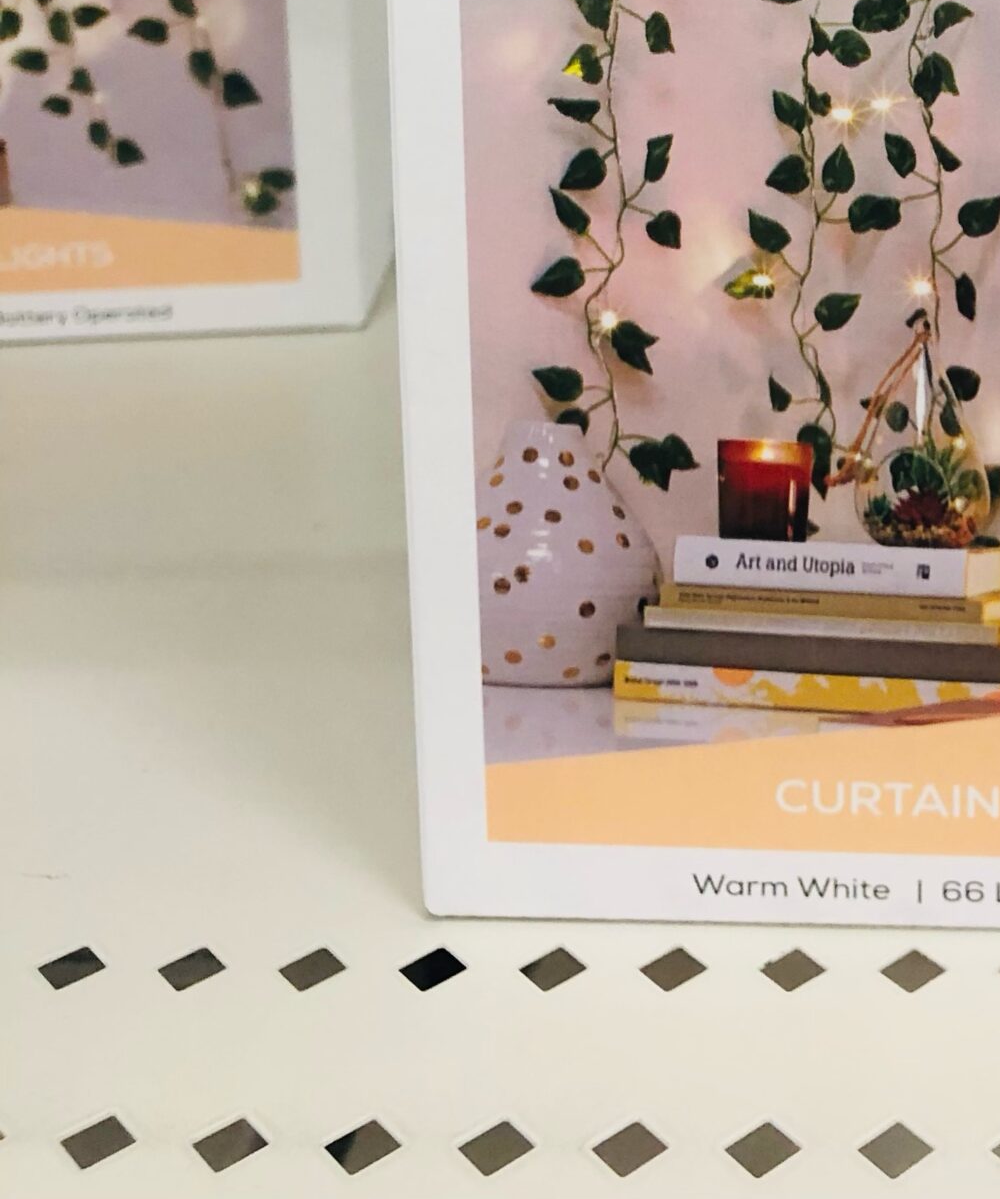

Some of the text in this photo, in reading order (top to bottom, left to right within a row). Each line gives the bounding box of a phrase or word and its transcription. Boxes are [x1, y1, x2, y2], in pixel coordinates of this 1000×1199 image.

[736, 552, 761, 571] Art
[766, 555, 797, 573] and
[803, 556, 856, 578] Utopia
[775, 778, 1000, 819] CURTAIN
[692, 873, 788, 897] Warm
[797, 876, 891, 900] White
[942, 880, 985, 903] 66
